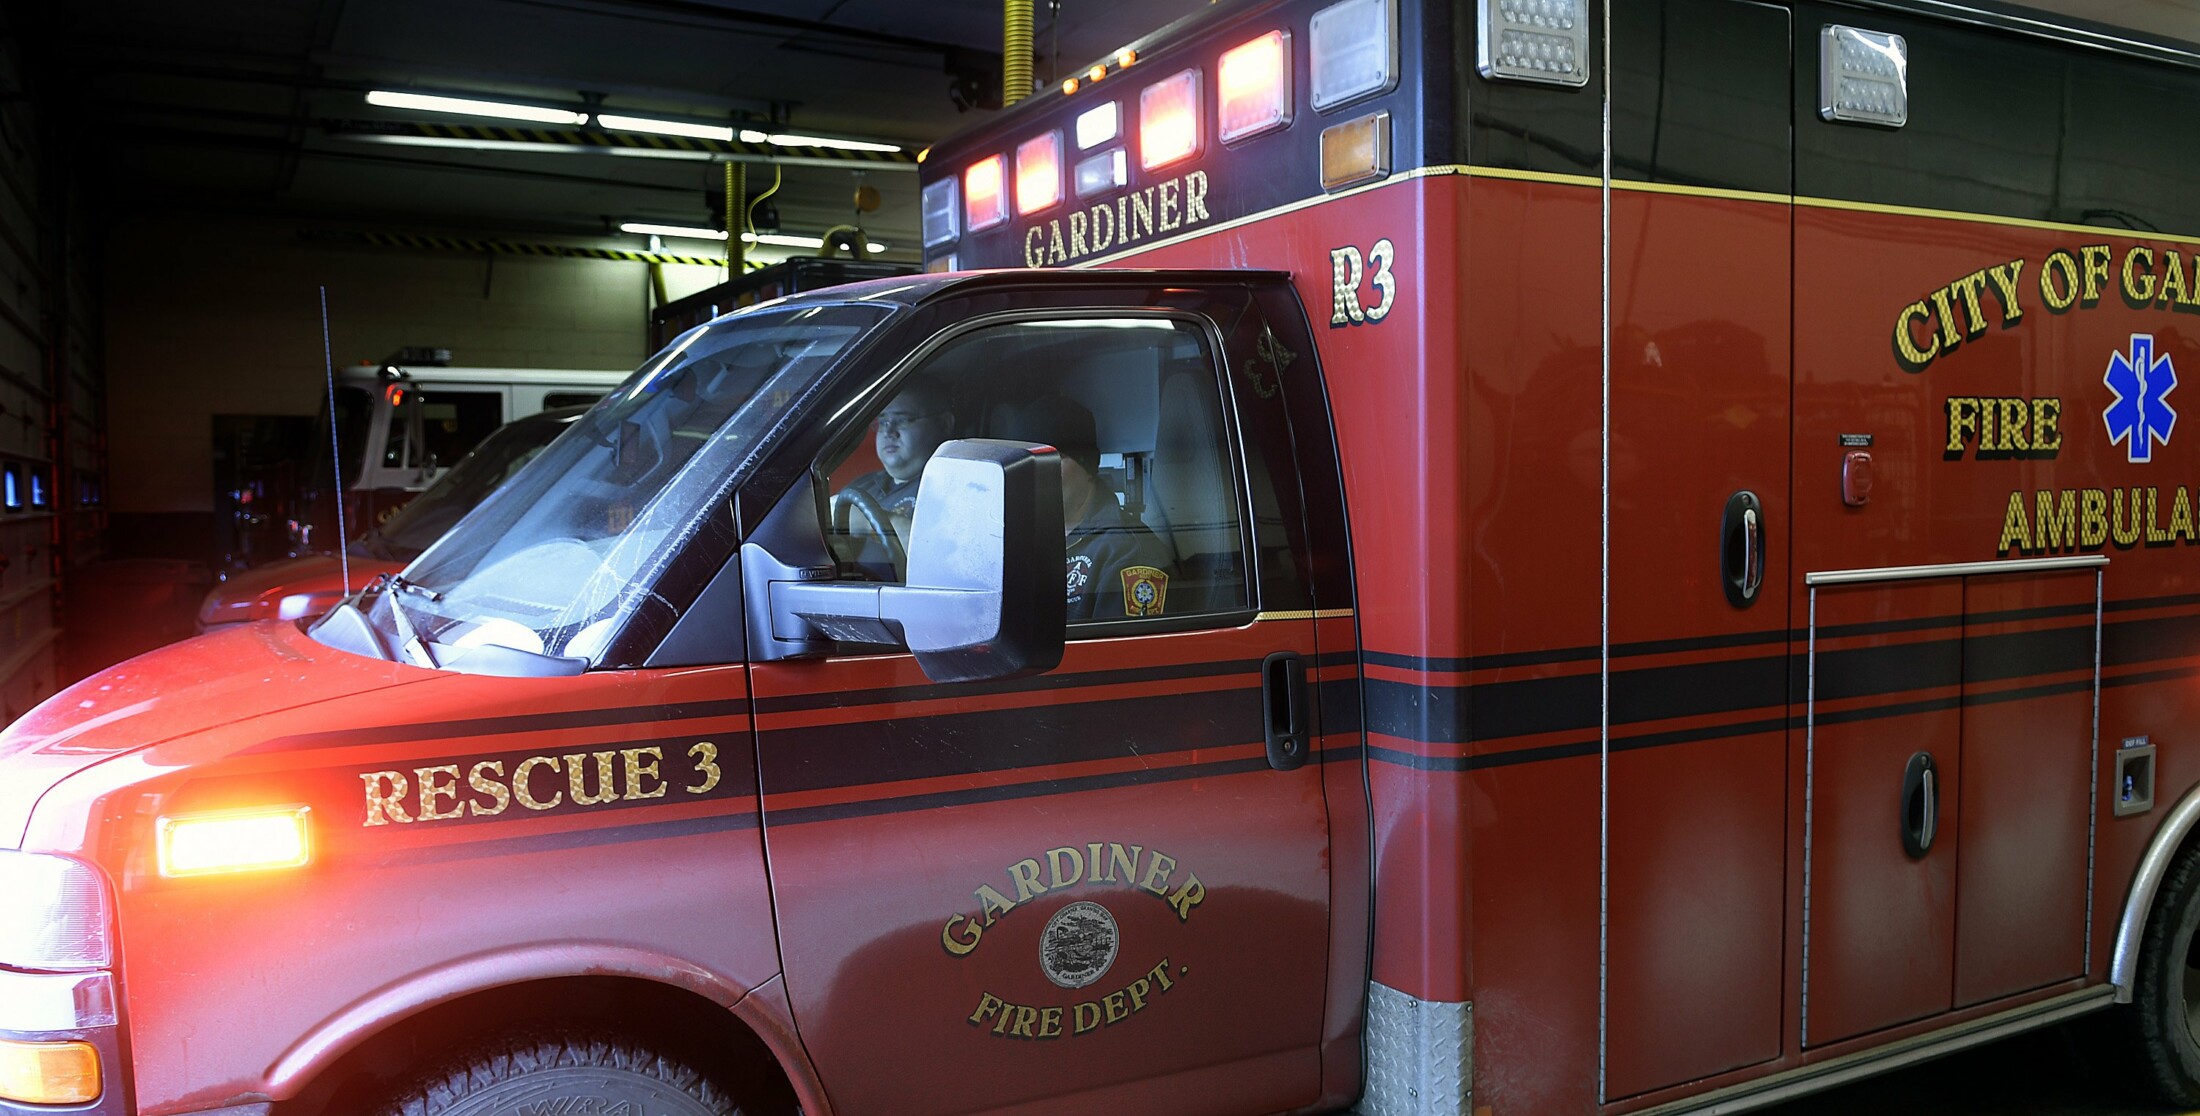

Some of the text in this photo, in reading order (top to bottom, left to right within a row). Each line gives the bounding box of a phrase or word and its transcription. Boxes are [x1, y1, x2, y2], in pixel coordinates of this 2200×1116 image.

[1025, 170, 1209, 268] GARDINER
[1329, 238, 1396, 326] R3
[1893, 258, 2025, 368] CITY
[2039, 245, 2112, 312] OF
[1945, 396, 2063, 456] FIRE
[1998, 485, 2200, 553] AMBULA
[359, 741, 722, 827] RESCUE 3
[941, 842, 1206, 956] GARDINER
[968, 991, 1064, 1039] FIRE
